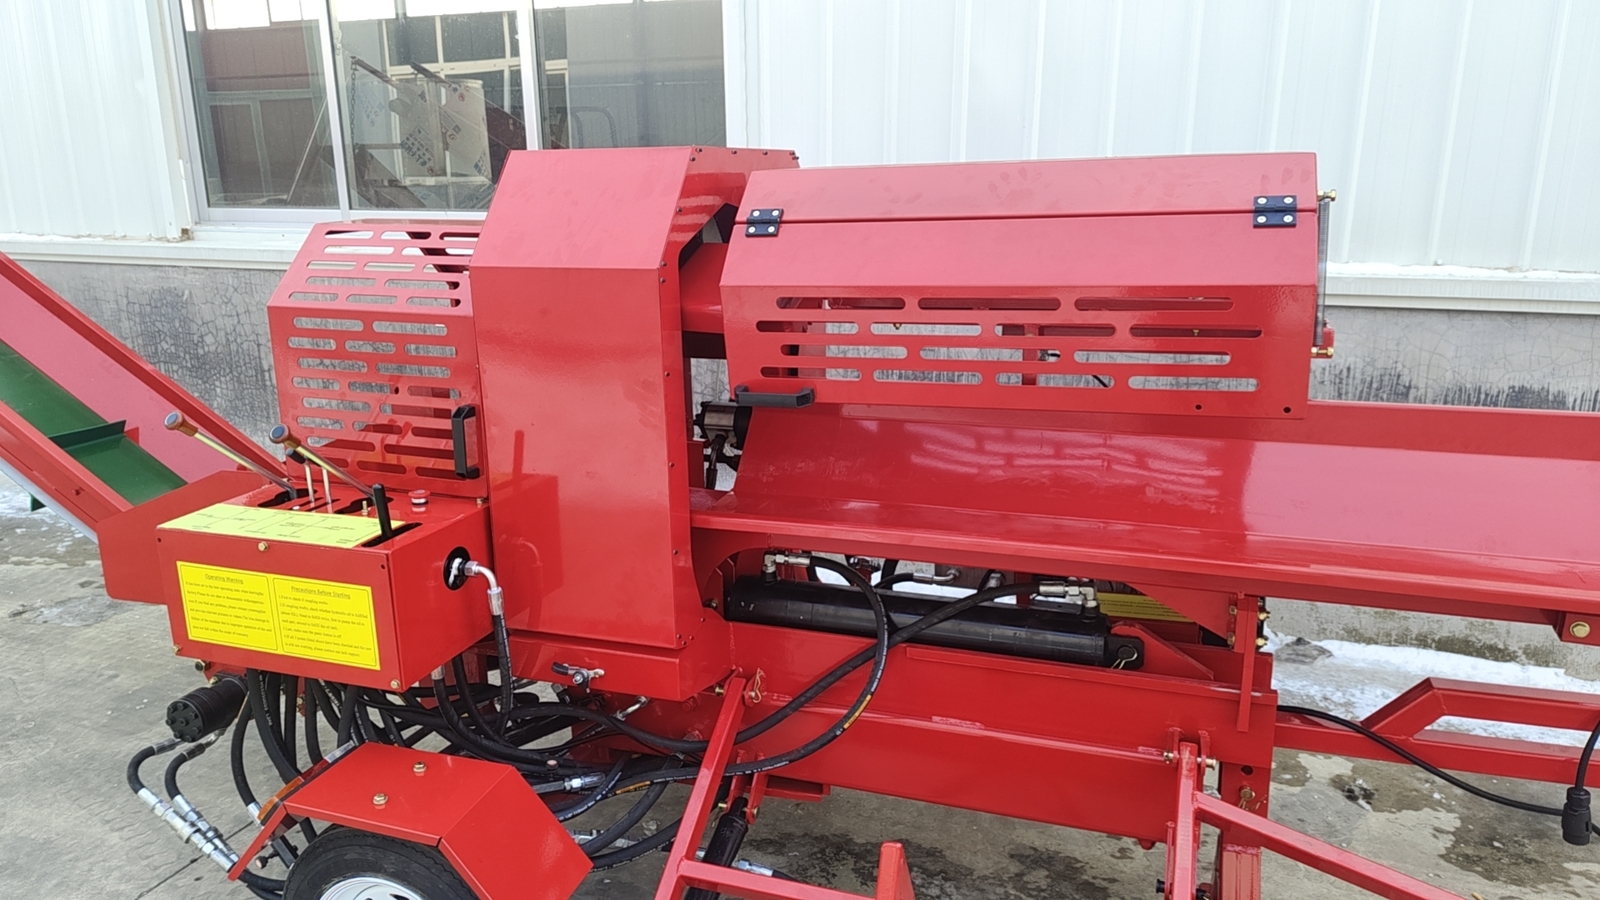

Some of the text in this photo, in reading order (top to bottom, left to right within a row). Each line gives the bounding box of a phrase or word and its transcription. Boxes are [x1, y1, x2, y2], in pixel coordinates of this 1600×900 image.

[205, 573, 226, 582] Operating
[291, 586, 316, 595] Precautions
[332, 591, 351, 600] Starting
